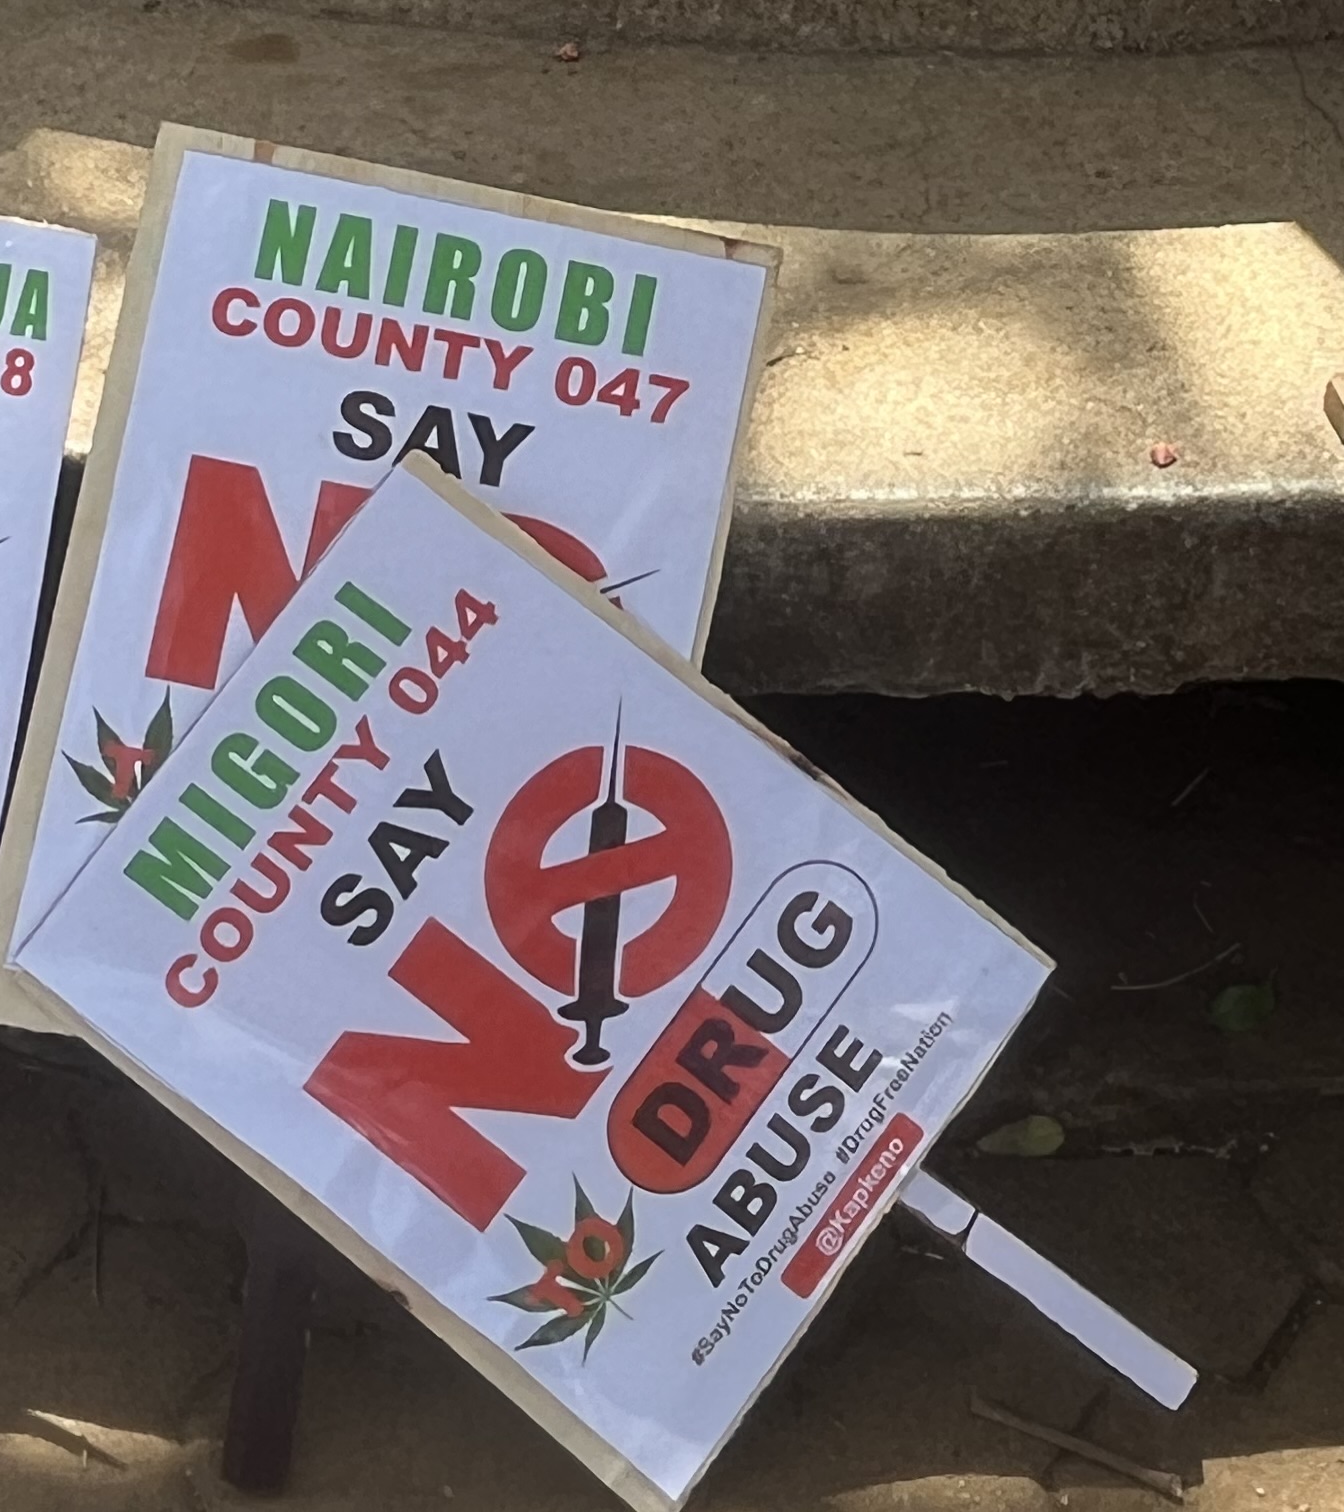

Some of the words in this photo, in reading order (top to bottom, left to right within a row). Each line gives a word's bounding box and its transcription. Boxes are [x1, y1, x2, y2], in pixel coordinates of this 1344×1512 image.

[211, 288, 533, 391] COUNTY
[554, 357, 690, 424] 047
[254, 199, 658, 357] NAIROBI
[332, 390, 536, 487] SAY
[123, 580, 414, 922] MIGORI
[165, 714, 393, 1011] COUNTY
[387, 589, 500, 718] 044
[319, 749, 475, 947] SAY
[302, 745, 733, 1233] NO
[526, 1207, 622, 1320] TO
[631, 888, 855, 1167] DRUG
[684, 1025, 882, 1288] ABUSE
[691, 1170, 836, 1366] #SayNoToDrugAbuse
[835, 1012, 954, 1165] #DrugFreeNation
[816, 1137, 905, 1256] @Kapkeno
